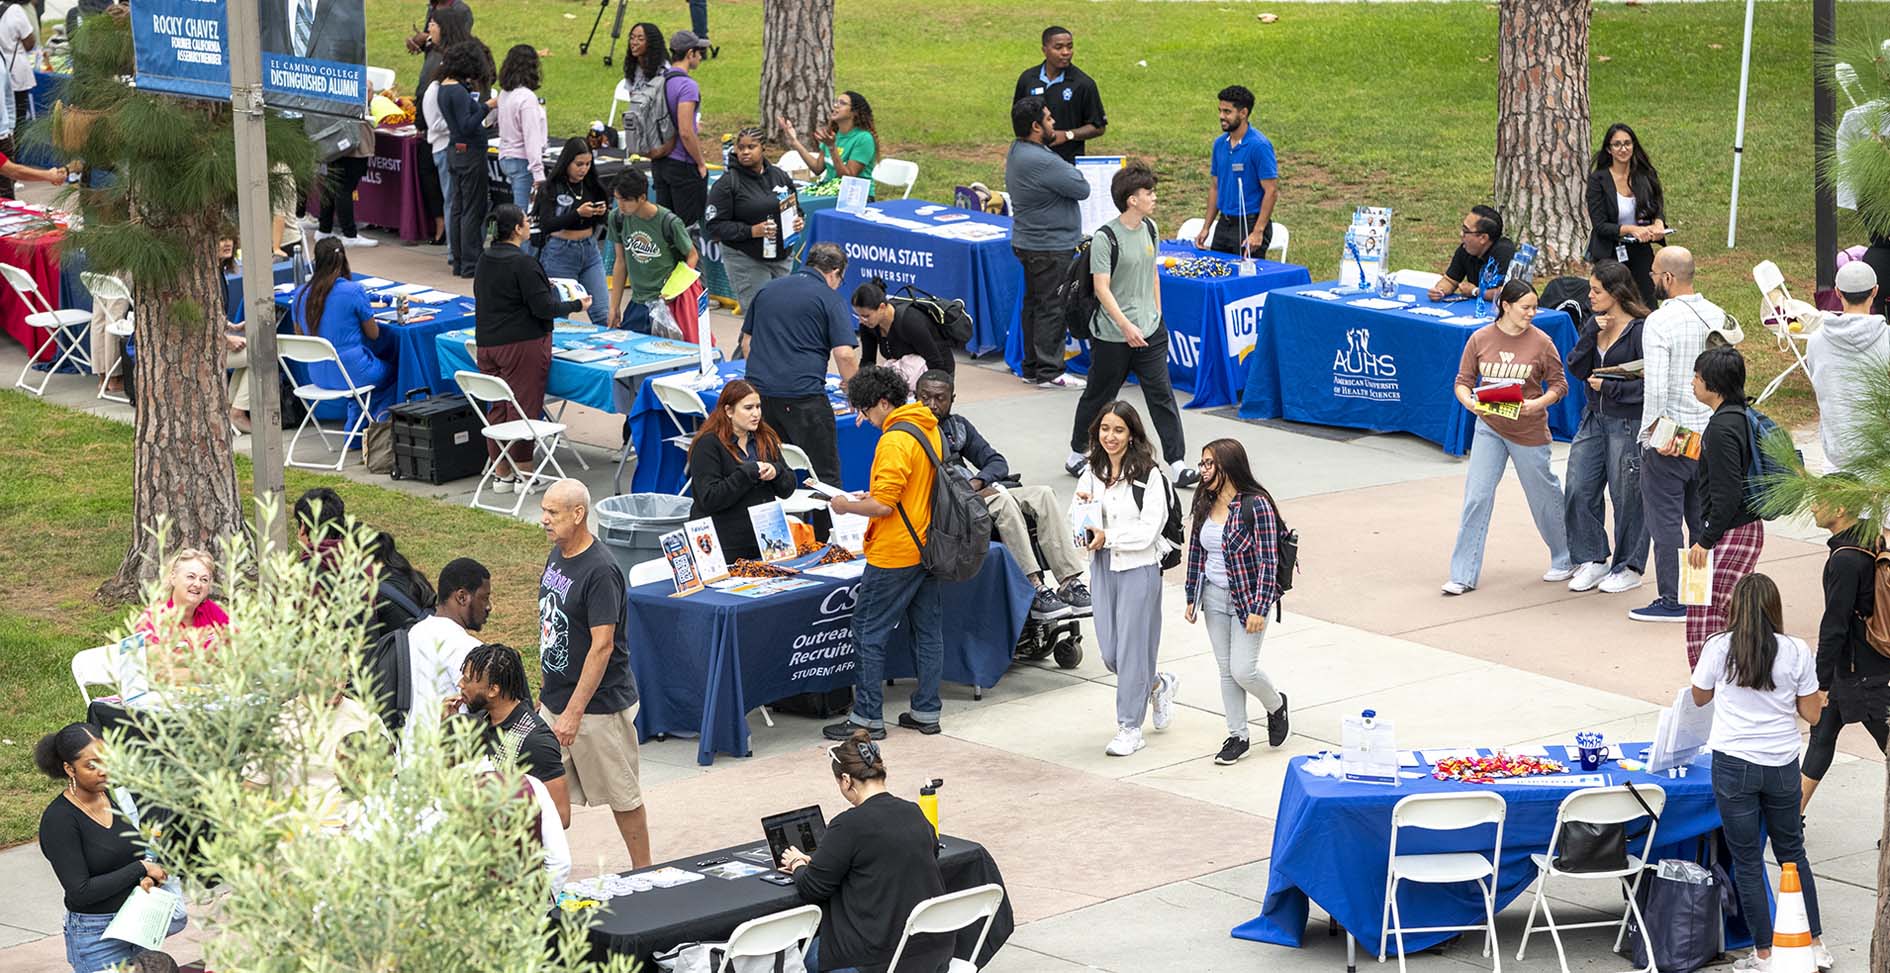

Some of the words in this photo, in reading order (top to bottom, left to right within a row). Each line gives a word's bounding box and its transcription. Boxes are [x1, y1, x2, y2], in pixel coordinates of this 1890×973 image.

[153, 14, 183, 36] ROCKY
[185, 18, 219, 40] CHAVEZ
[171, 36, 192, 50] FORMER
[192, 38, 222, 53] CALIFORNIA
[271, 60, 280, 69] EL
[283, 62, 317, 74] CAMINO
[320, 67, 359, 80] COLLEGE
[270, 68, 327, 92] DISTINGUISHED
[328, 78, 359, 97] ALUMNI
[845, 242, 897, 264] SONOMA
[898, 249, 934, 268] STATE
[861, 267, 916, 284] UNIVERSITY
[1333, 349, 1396, 376] AUHS
[792, 628, 854, 649] Outreac
[791, 665, 836, 681] STUDENT
